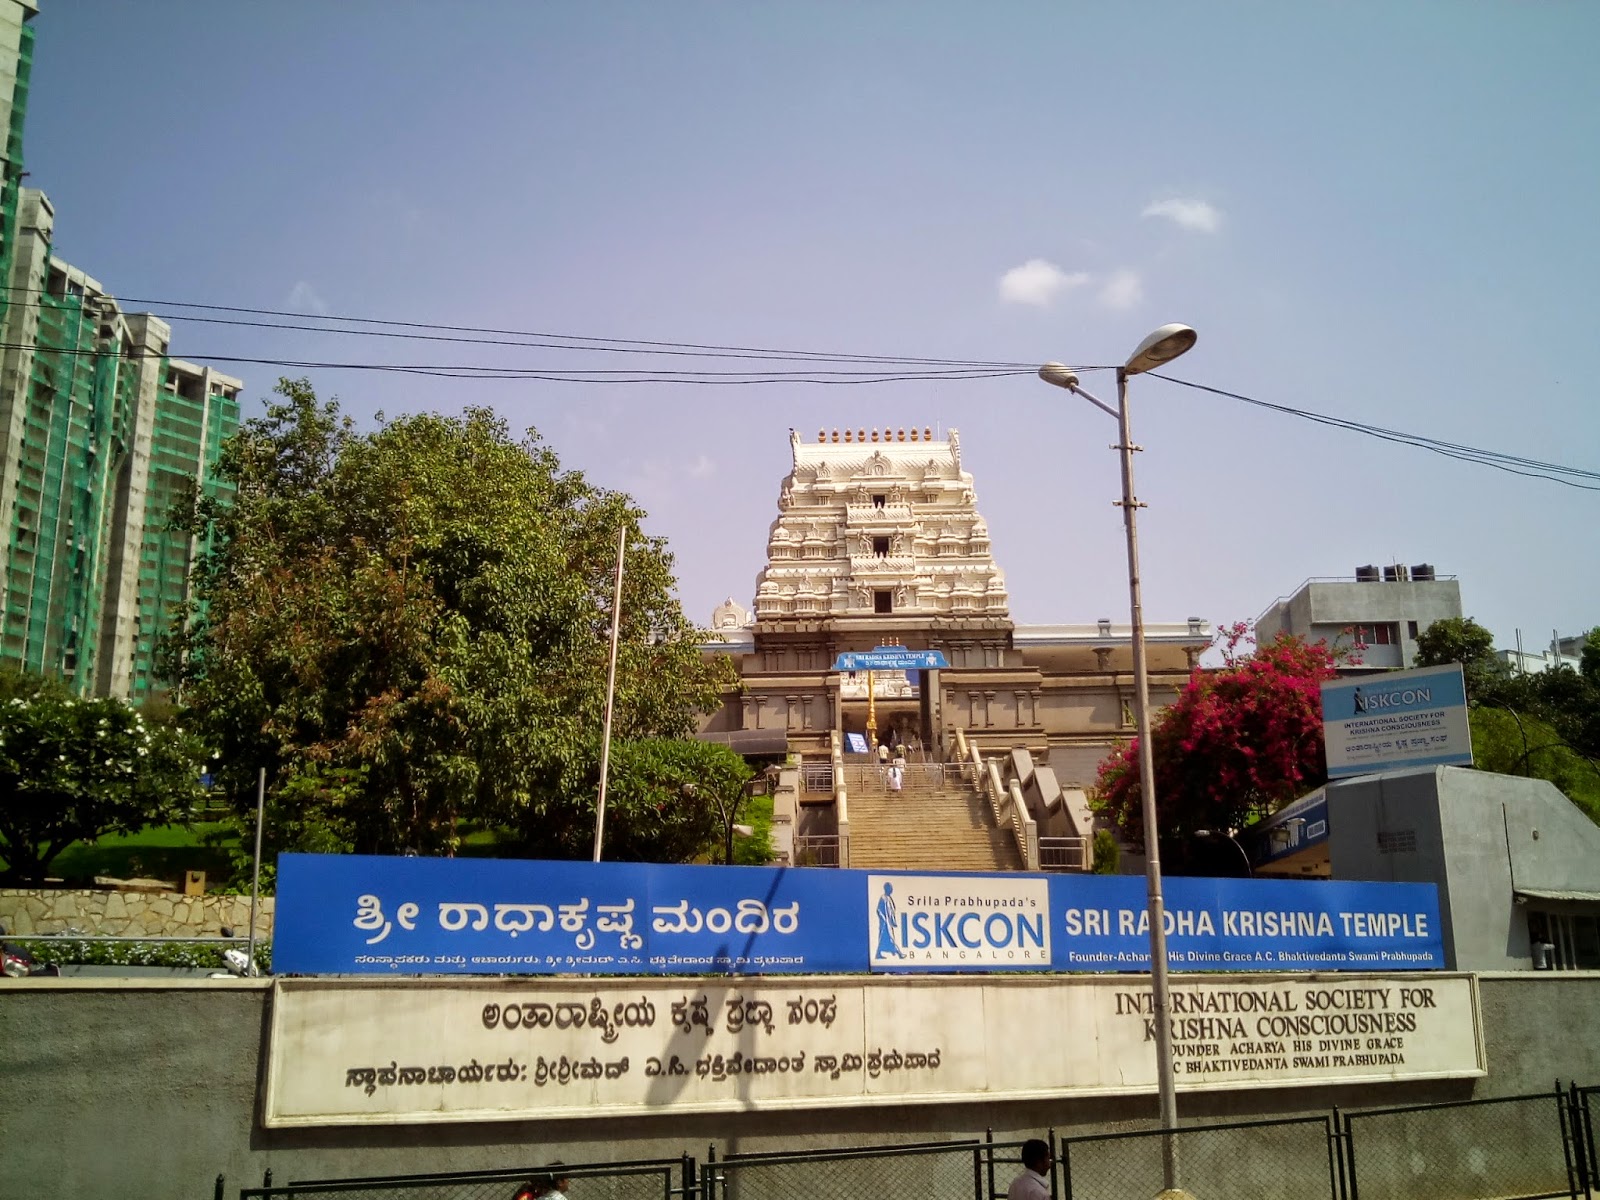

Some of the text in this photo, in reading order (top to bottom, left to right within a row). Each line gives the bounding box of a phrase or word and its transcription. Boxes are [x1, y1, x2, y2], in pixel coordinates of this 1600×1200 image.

[1364, 688, 1431, 710] ISKCON
[1344, 717, 1397, 729] INTERNATIONAL
[1398, 713, 1428, 722] SOCIETY
[1350, 727, 1380, 735] KRISHNA
[1381, 719, 1441, 732] CONSCIOUSNESS
[907, 896, 1036, 909] Srila Prabhupada's
[353, 894, 800, 951] ಶ್ರೀ ರಾಧಾಕೃಷ್ಣ ಮಂದಿರ
[901, 912, 1044, 949] ISKCON
[1065, 908, 1429, 938] SRI RADHA KRISHNA TEMPLE
[909, 950, 1046, 959] BANGALORE
[1069, 951, 1433, 964] Founder-Achar His Divine Grace A.C. Bhaktivedanta Swami Prabhupada
[1115, 988, 1437, 1015] INTRNATIONAL SOCIETY FOR
[1257, 1013, 1416, 1038] CONSCIOUSNESS
[1231, 1041, 1286, 1055] ACHARYA
[1293, 1040, 1312, 1052] HIS
[1319, 1038, 1360, 1051] DIVINE
[1367, 1037, 1403, 1049] GRACE
[1186, 1057, 1288, 1074] BHAKTIVEDANTA
[1293, 1055, 1329, 1068] SWAMI
[1333, 1053, 1405, 1066] PRABHUPADA
